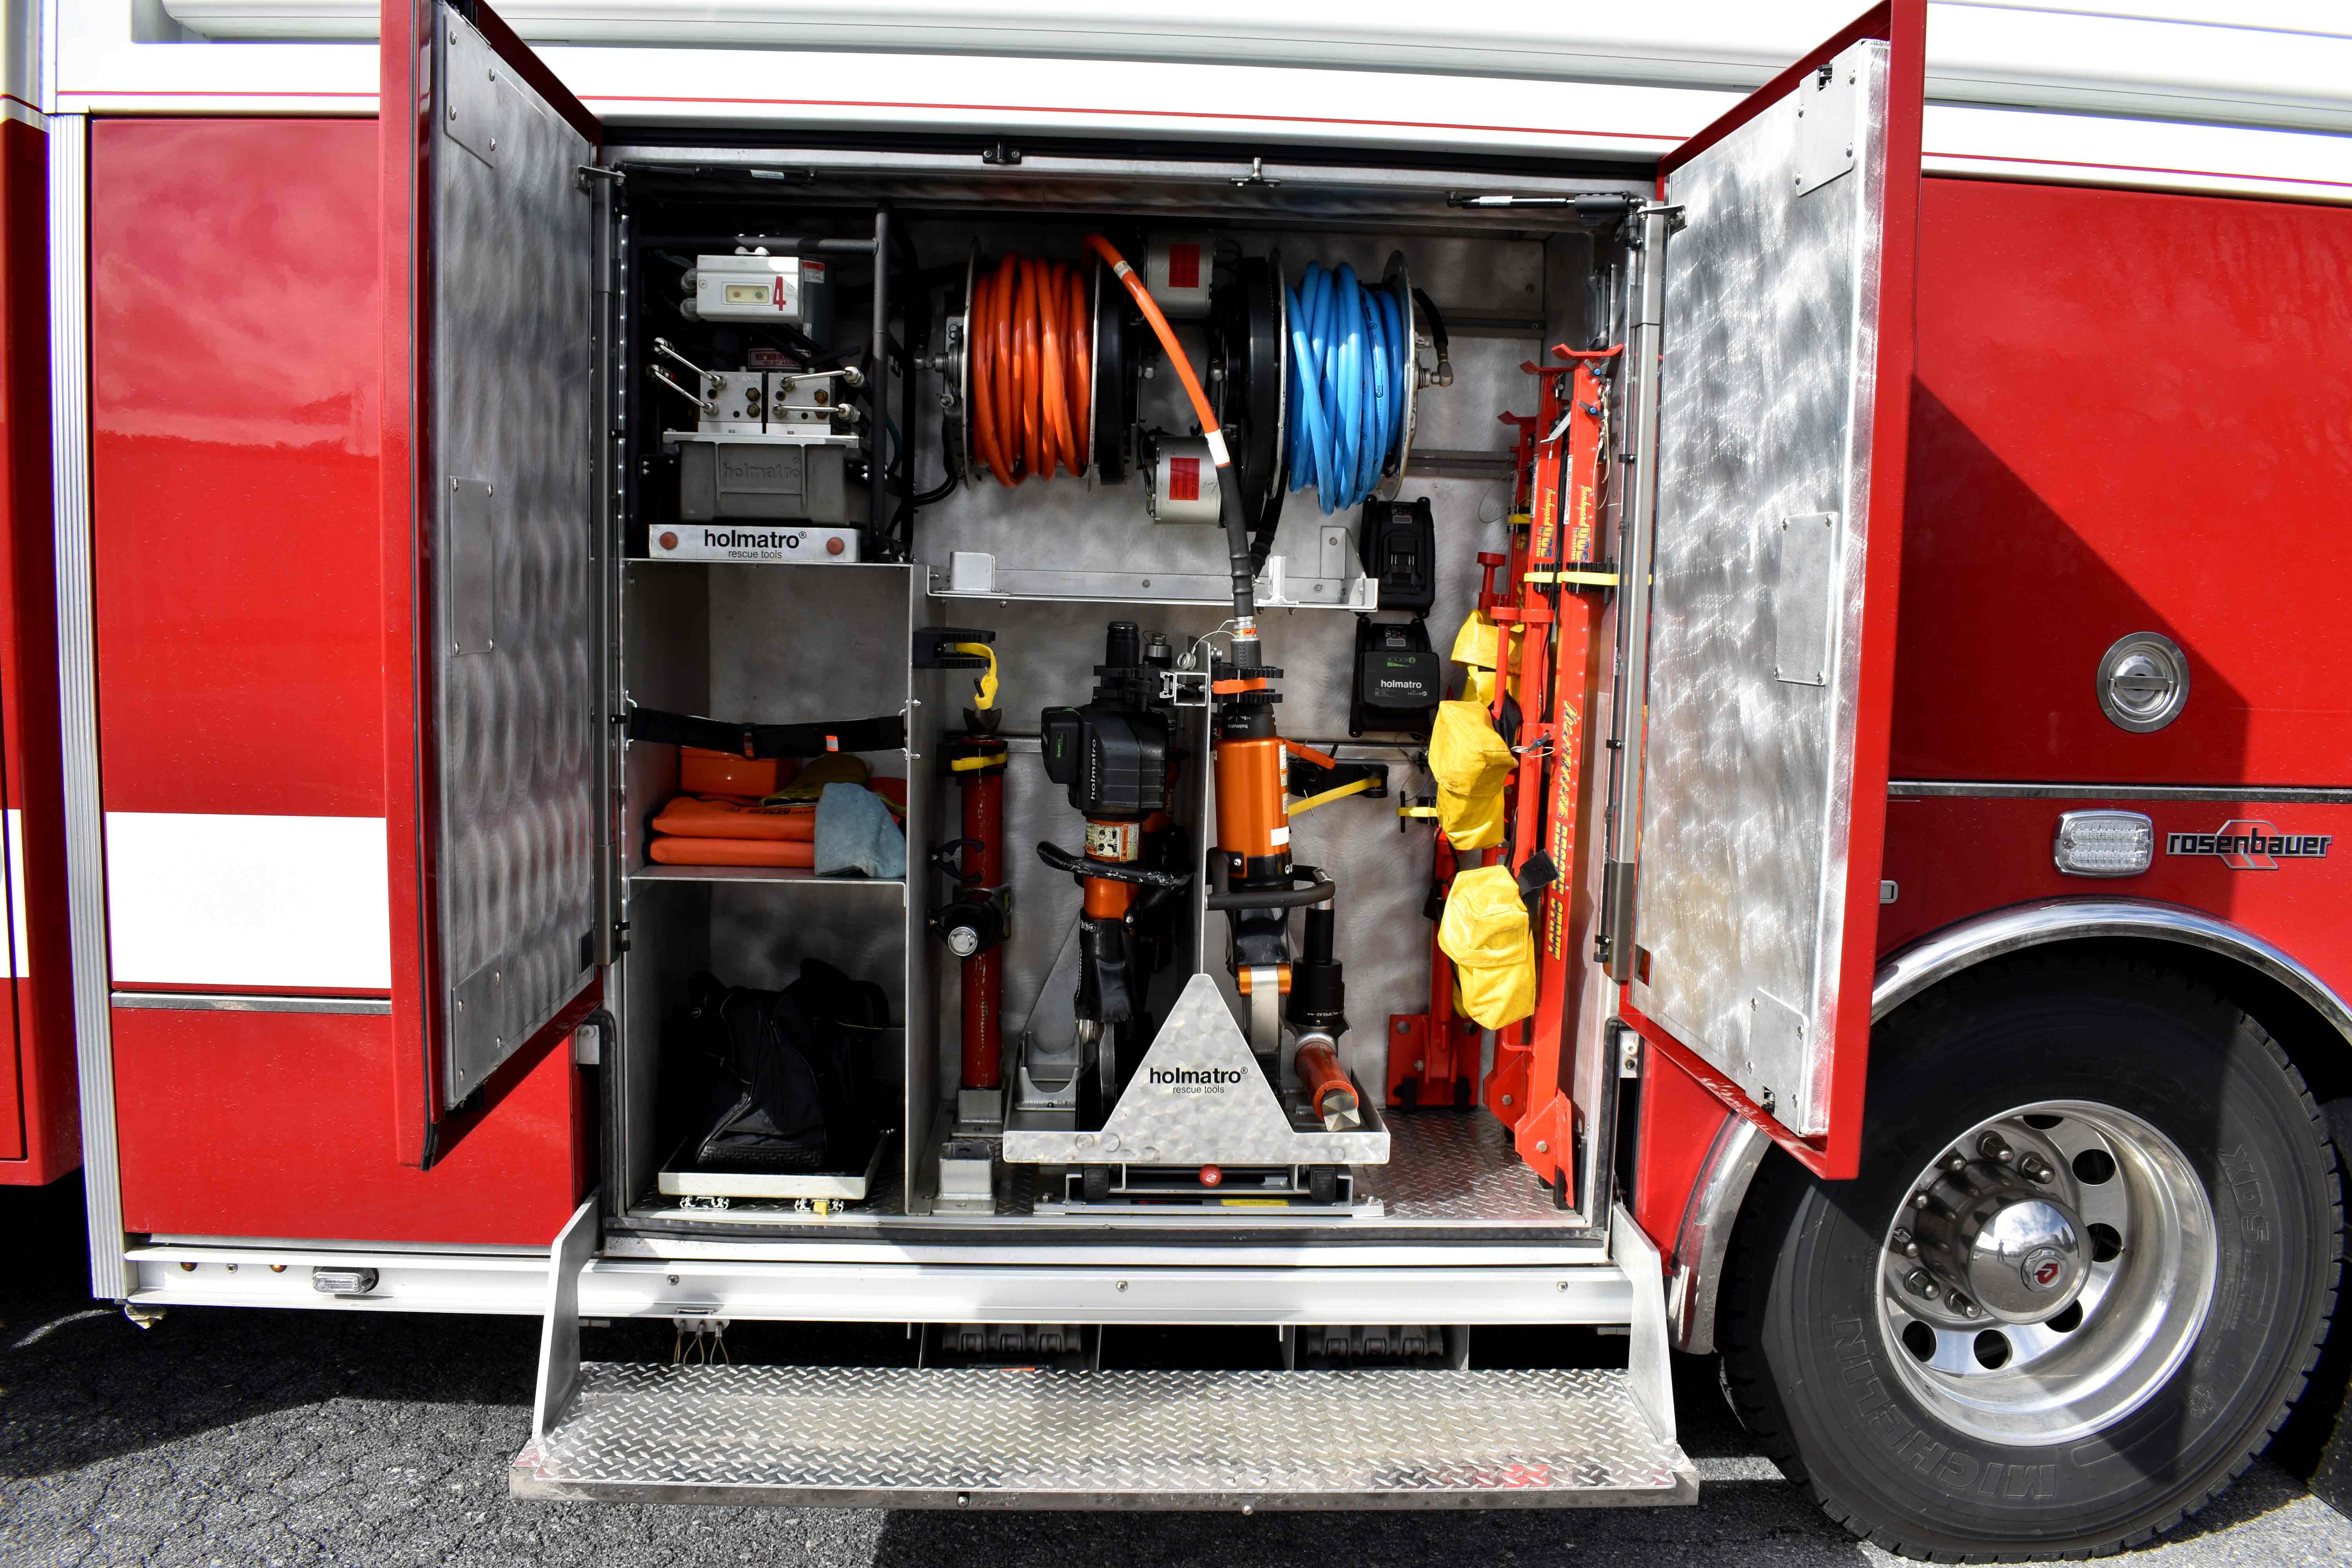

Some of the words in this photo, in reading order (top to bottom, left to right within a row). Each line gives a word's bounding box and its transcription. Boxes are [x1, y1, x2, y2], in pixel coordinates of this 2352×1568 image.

[773, 276, 786, 311] 4
[1575, 483, 1593, 527] Junkyard
[728, 550, 759, 559] rescue
[761, 550, 782, 559] tools
[1576, 527, 1592, 562] DOG
[1380, 679, 1422, 689] holmatro
[2169, 827, 2331, 855] rosenbauer
[1548, 897, 1564, 962] STRUT
[1204, 1085, 1225, 1094] tools
[1832, 1317, 2057, 1499] MICHELIN
